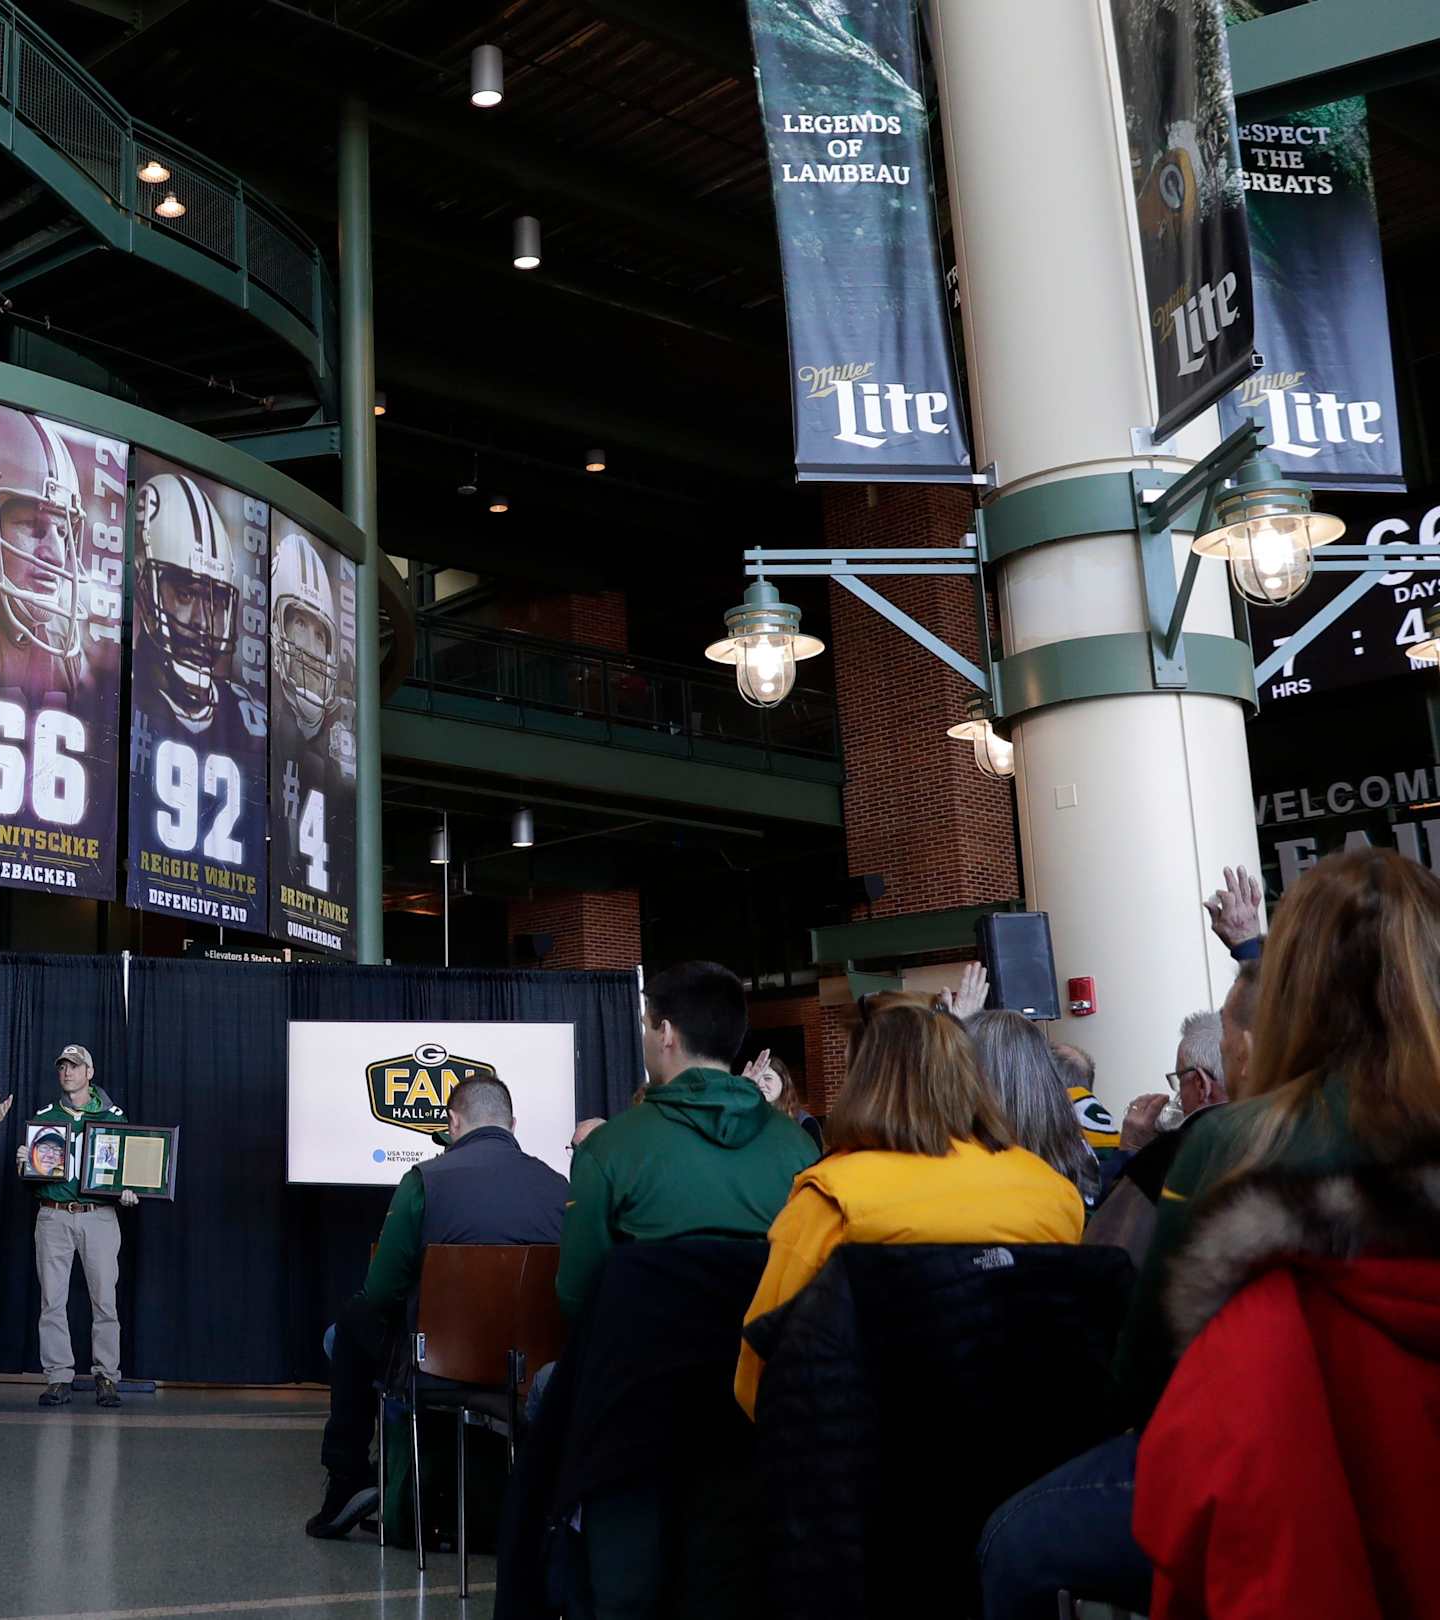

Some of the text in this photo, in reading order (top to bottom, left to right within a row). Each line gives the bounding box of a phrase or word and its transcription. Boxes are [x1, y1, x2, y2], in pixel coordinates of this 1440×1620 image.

[782, 113, 902, 135] LEGENDS
[1238, 124, 1330, 145] ESPECT
[826, 139, 864, 158] OF
[1250, 148, 1305, 169] THE
[781, 164, 910, 185] LAMBEAU
[1238, 170, 1333, 194] GREATS
[1170, 271, 1239, 377] Lite
[798, 361, 875, 399] Miller
[829, 380, 949, 448] Lite
[1259, 389, 1384, 457] Lite
[89, 438, 129, 644] 1958-72
[242, 497, 267, 688] 1993-98
[1395, 581, 1440, 604] DAY
[1272, 678, 1312, 699] HRS
[155, 740, 243, 865] 92
[299, 789, 329, 893] 4
[140, 851, 257, 896] REGGIE WHITE
[149, 888, 248, 923] DEFENSIVE END
[280, 885, 350, 924] BRETT FAVRE
[287, 921, 342, 951] QUARTERBACK
[209, 950, 242, 962] Elevators
[392, 1107, 425, 1119] HALL
[433, 1108, 449, 1119] FA
